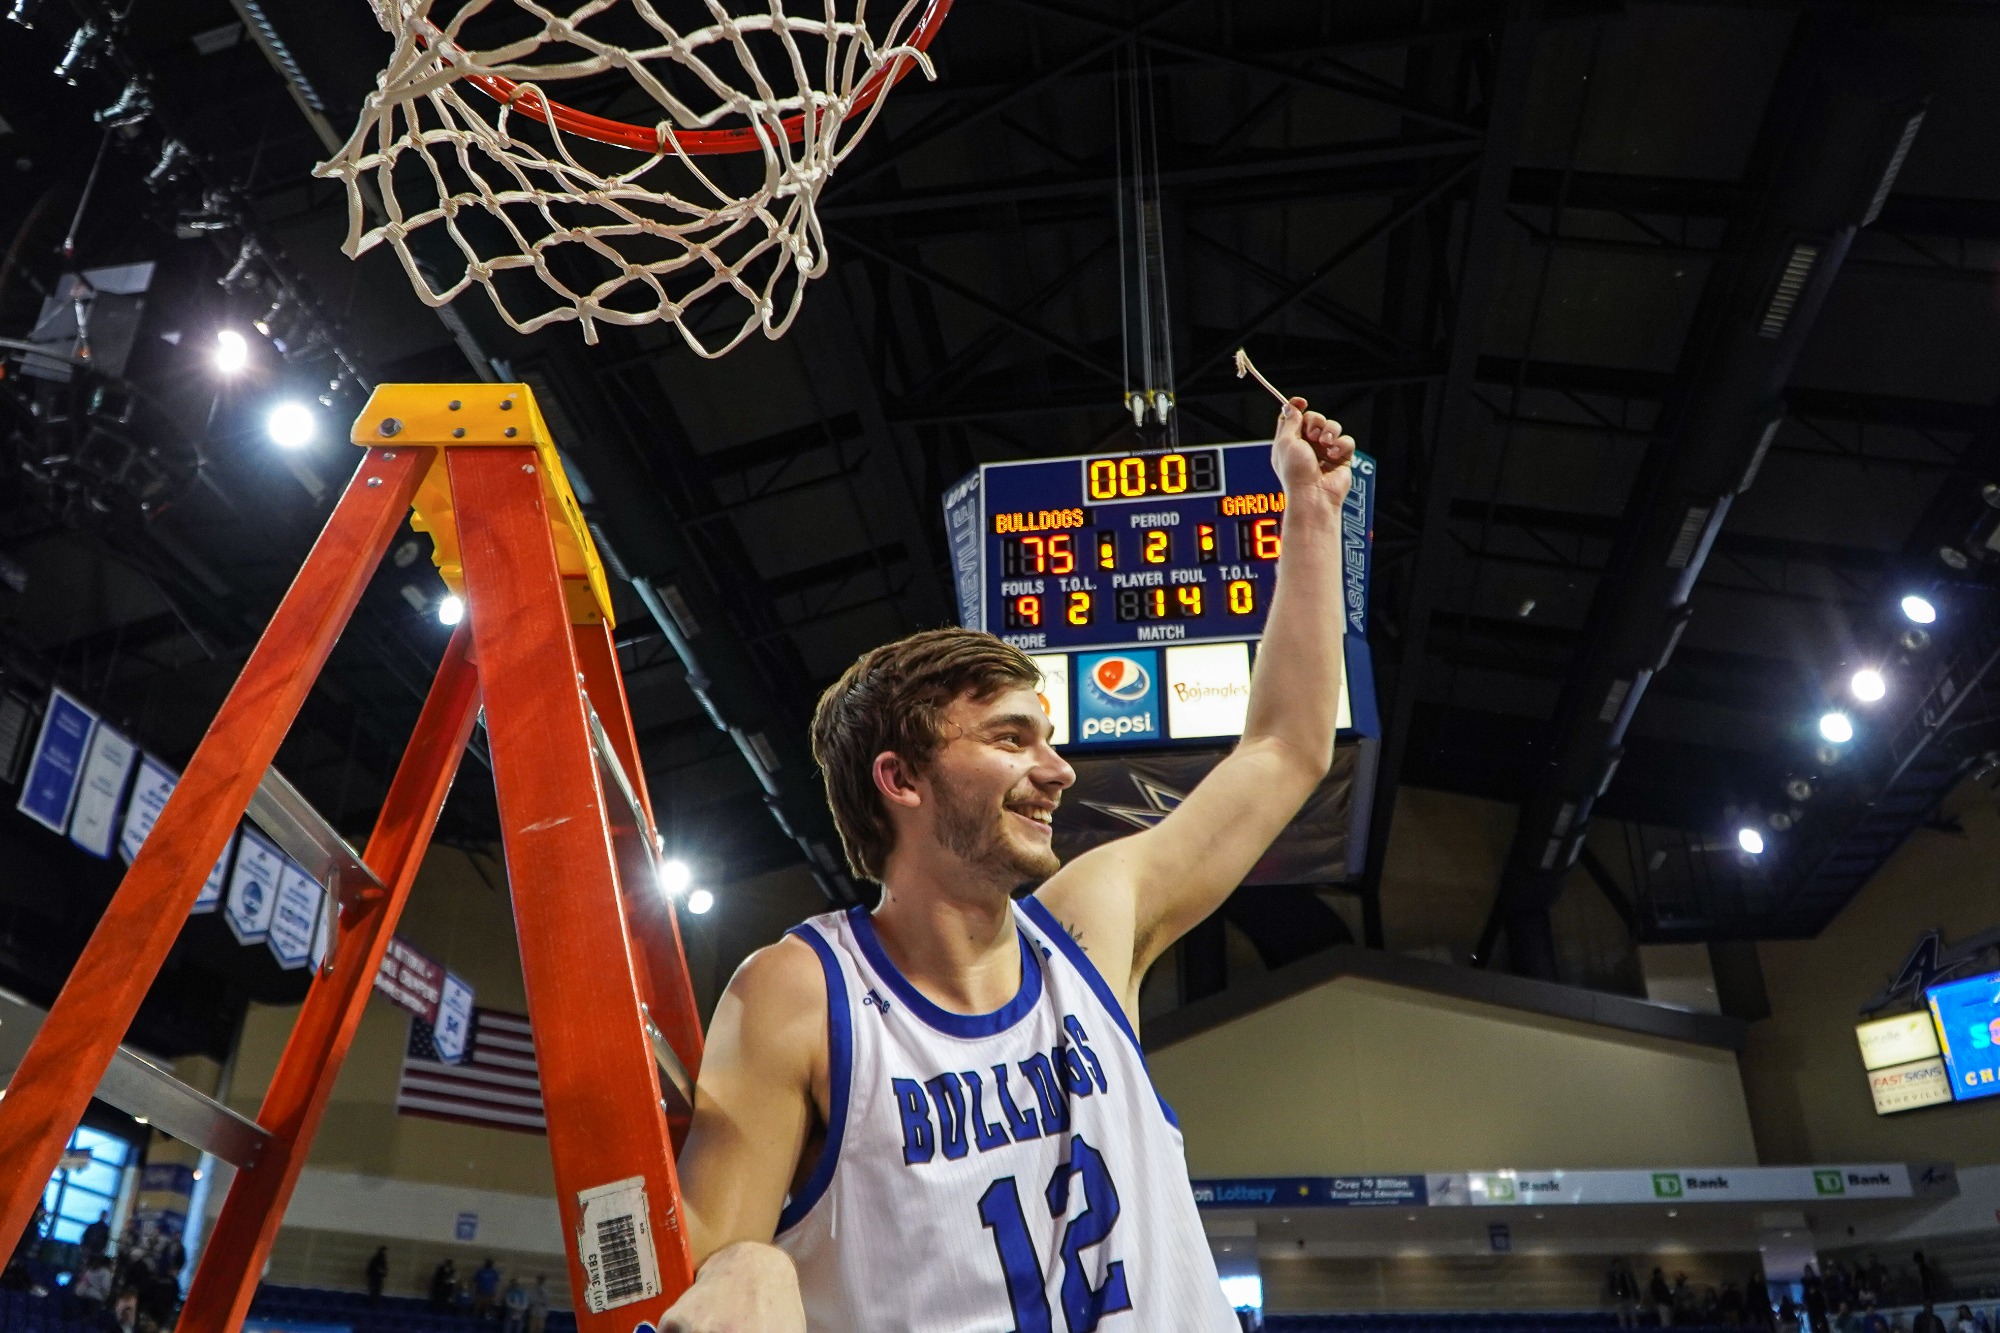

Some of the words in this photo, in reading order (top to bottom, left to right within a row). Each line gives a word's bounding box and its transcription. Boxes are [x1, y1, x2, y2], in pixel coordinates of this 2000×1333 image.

[1091, 454, 1187, 498] 00.0
[995, 508, 1084, 534] BULLDOGS
[1130, 511, 1180, 528] PERIOD
[1146, 530, 1168, 564] 2
[1254, 518, 1281, 560] 6
[952, 497, 981, 630] SHEVILLE
[1021, 534, 1075, 574] 75
[1342, 475, 1366, 633] ASHEVILLE
[1060, 577, 1097, 592] T.O.L.
[1112, 572, 1164, 588] PLAYER
[1171, 569, 1207, 585] FOUL
[1219, 566, 1259, 581] T.O.L.
[1001, 579, 1045, 596] FOULS
[1229, 580, 1253, 615] 0
[1017, 595, 1040, 626] 9
[1068, 592, 1090, 625] 2
[1001, 633, 1047, 649] SCORE
[1137, 625, 1186, 641] MATCH
[1174, 681, 1248, 703] Bojangles
[1082, 712, 1152, 739] pepsi
[1965, 1067, 2000, 1086] CH
[1686, 1176, 1729, 1189] Bank
[1848, 1172, 1890, 1186] Bank
[1216, 1186, 1276, 1203] Lottery
[977, 1133, 1134, 1333] 12
